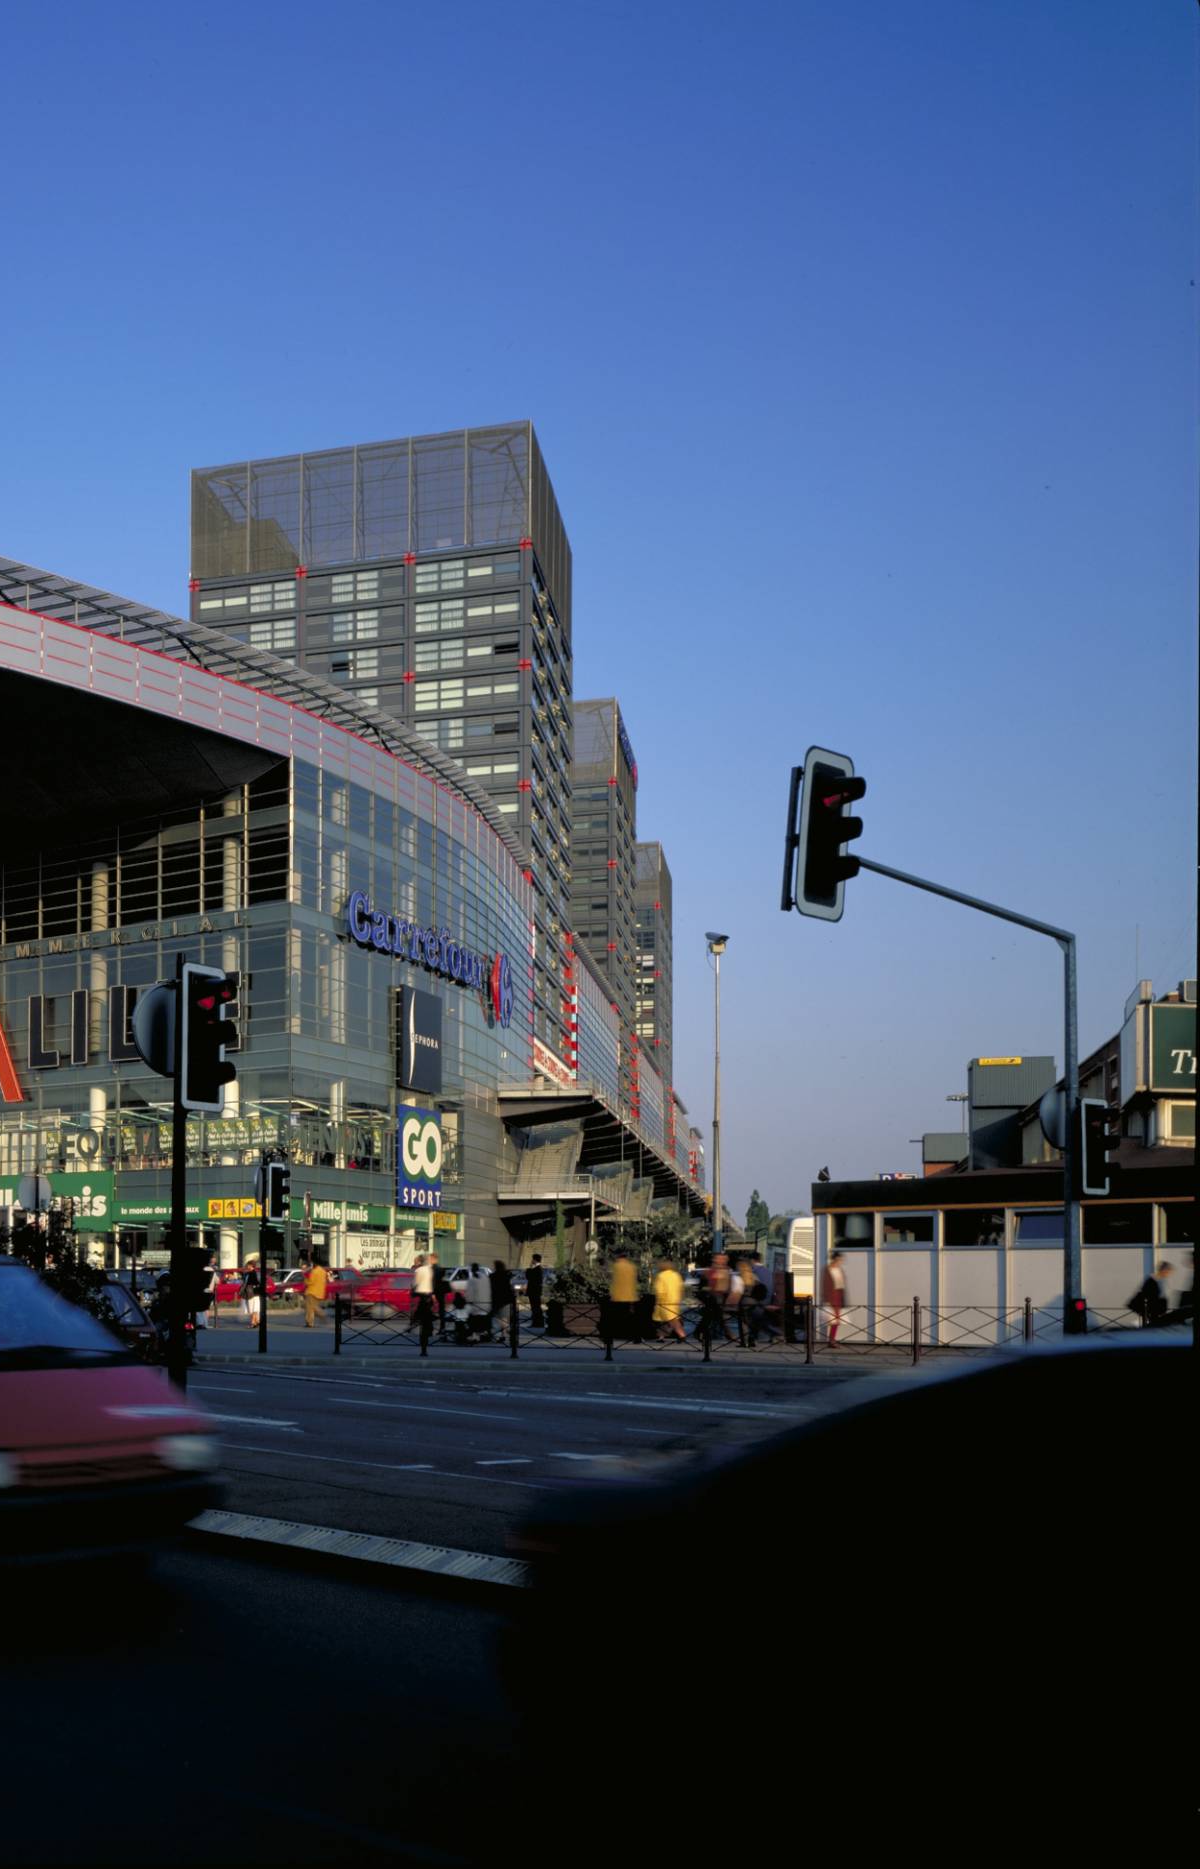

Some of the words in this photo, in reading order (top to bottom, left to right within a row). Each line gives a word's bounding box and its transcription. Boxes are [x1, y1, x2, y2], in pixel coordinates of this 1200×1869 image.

[349, 889, 484, 988] Carrefour
[402, 1117, 442, 1179] GO
[403, 1187, 441, 1206] SPORT
[155, 1206, 167, 1214] des
[313, 1201, 341, 1220] Mille
